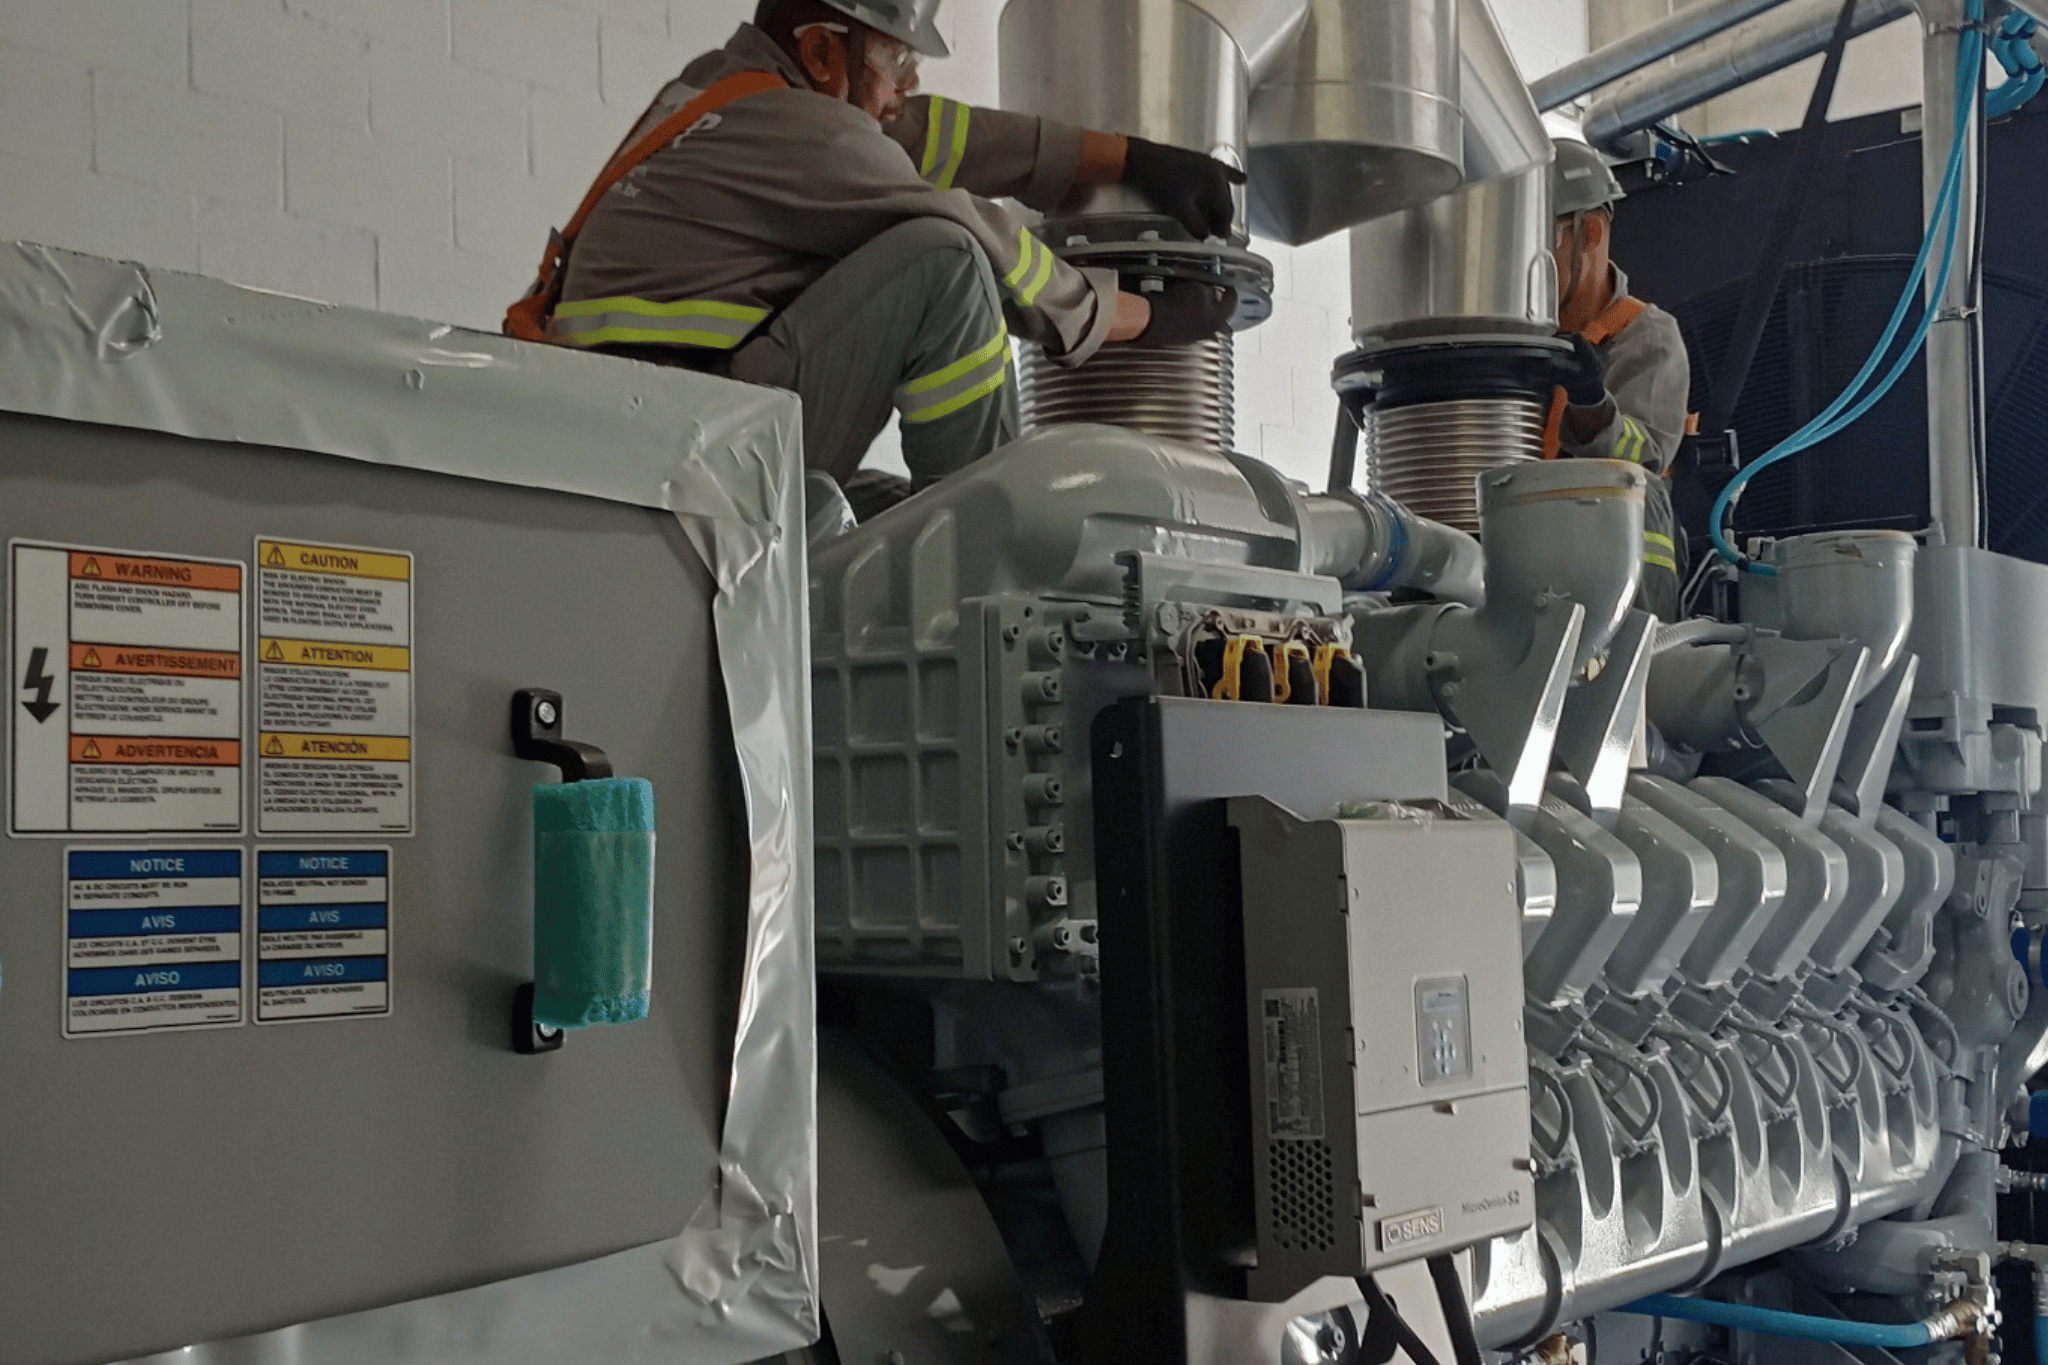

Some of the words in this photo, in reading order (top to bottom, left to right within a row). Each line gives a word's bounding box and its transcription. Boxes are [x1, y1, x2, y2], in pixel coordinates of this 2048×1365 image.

[300, 552, 358, 570] CAUTION
[115, 562, 192, 582] WARNING
[115, 653, 235, 671] AVERTISSEMENT
[301, 646, 373, 663] ATTENTION
[115, 744, 219, 759] ADVERTENCIA
[301, 739, 367, 753] ATENCIÓN
[130, 858, 185, 872] NOTICE
[299, 857, 348, 870] NOTICE
[142, 915, 175, 929] AVIS
[309, 910, 340, 923] AVIS
[304, 963, 345, 977] AVISO
[135, 971, 180, 986] AVISO
[1507, 1190, 1520, 1206] S2
[1402, 1212, 1439, 1240] SENS
